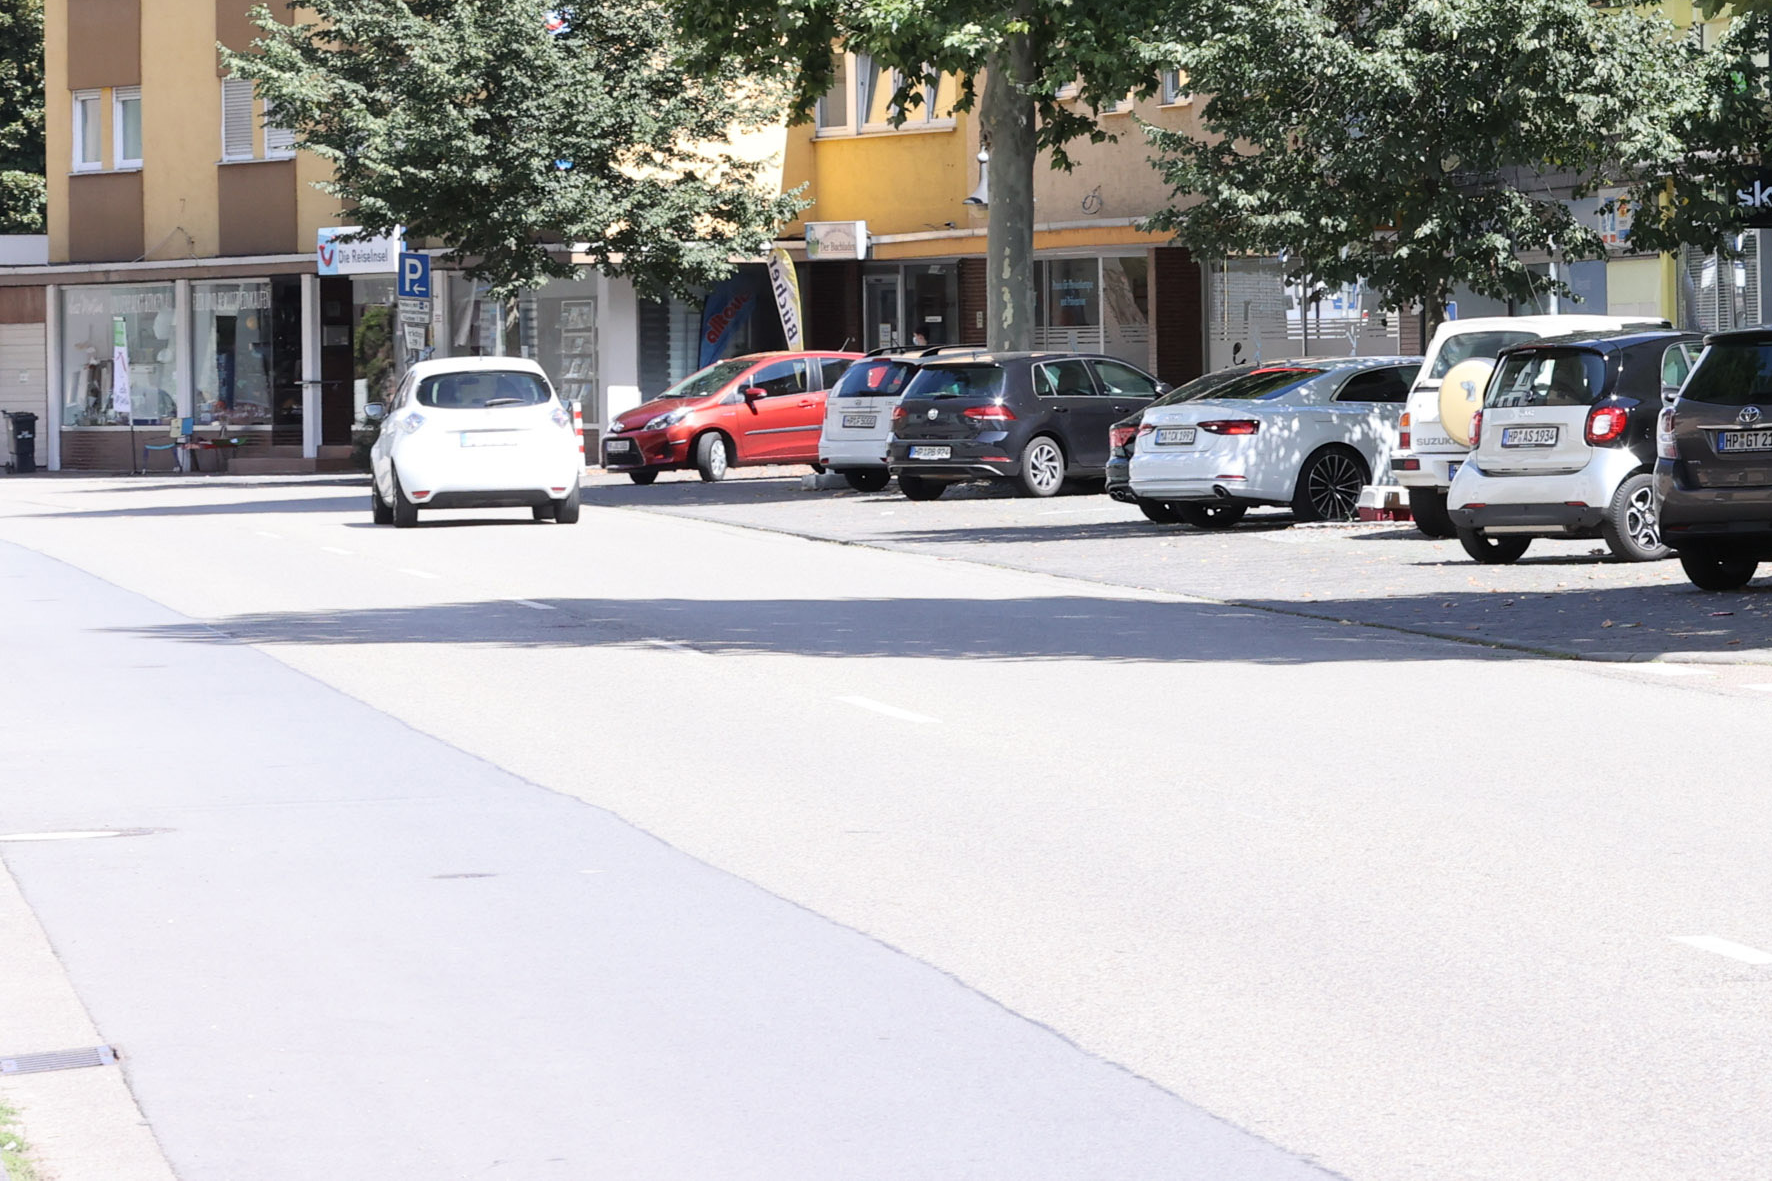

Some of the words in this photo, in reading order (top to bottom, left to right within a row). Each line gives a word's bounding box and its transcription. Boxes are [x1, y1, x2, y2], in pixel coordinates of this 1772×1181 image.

[338, 250, 350, 264] Die
[405, 258, 423, 292] P
[1416, 437, 1457, 446] SUZUK
[1508, 430, 1519, 443] HP
[1523, 430, 1534, 443] AS
[1534, 429, 1555, 443] 1934
[1725, 433, 1739, 448] HP
[1745, 432, 1759, 447] GT
